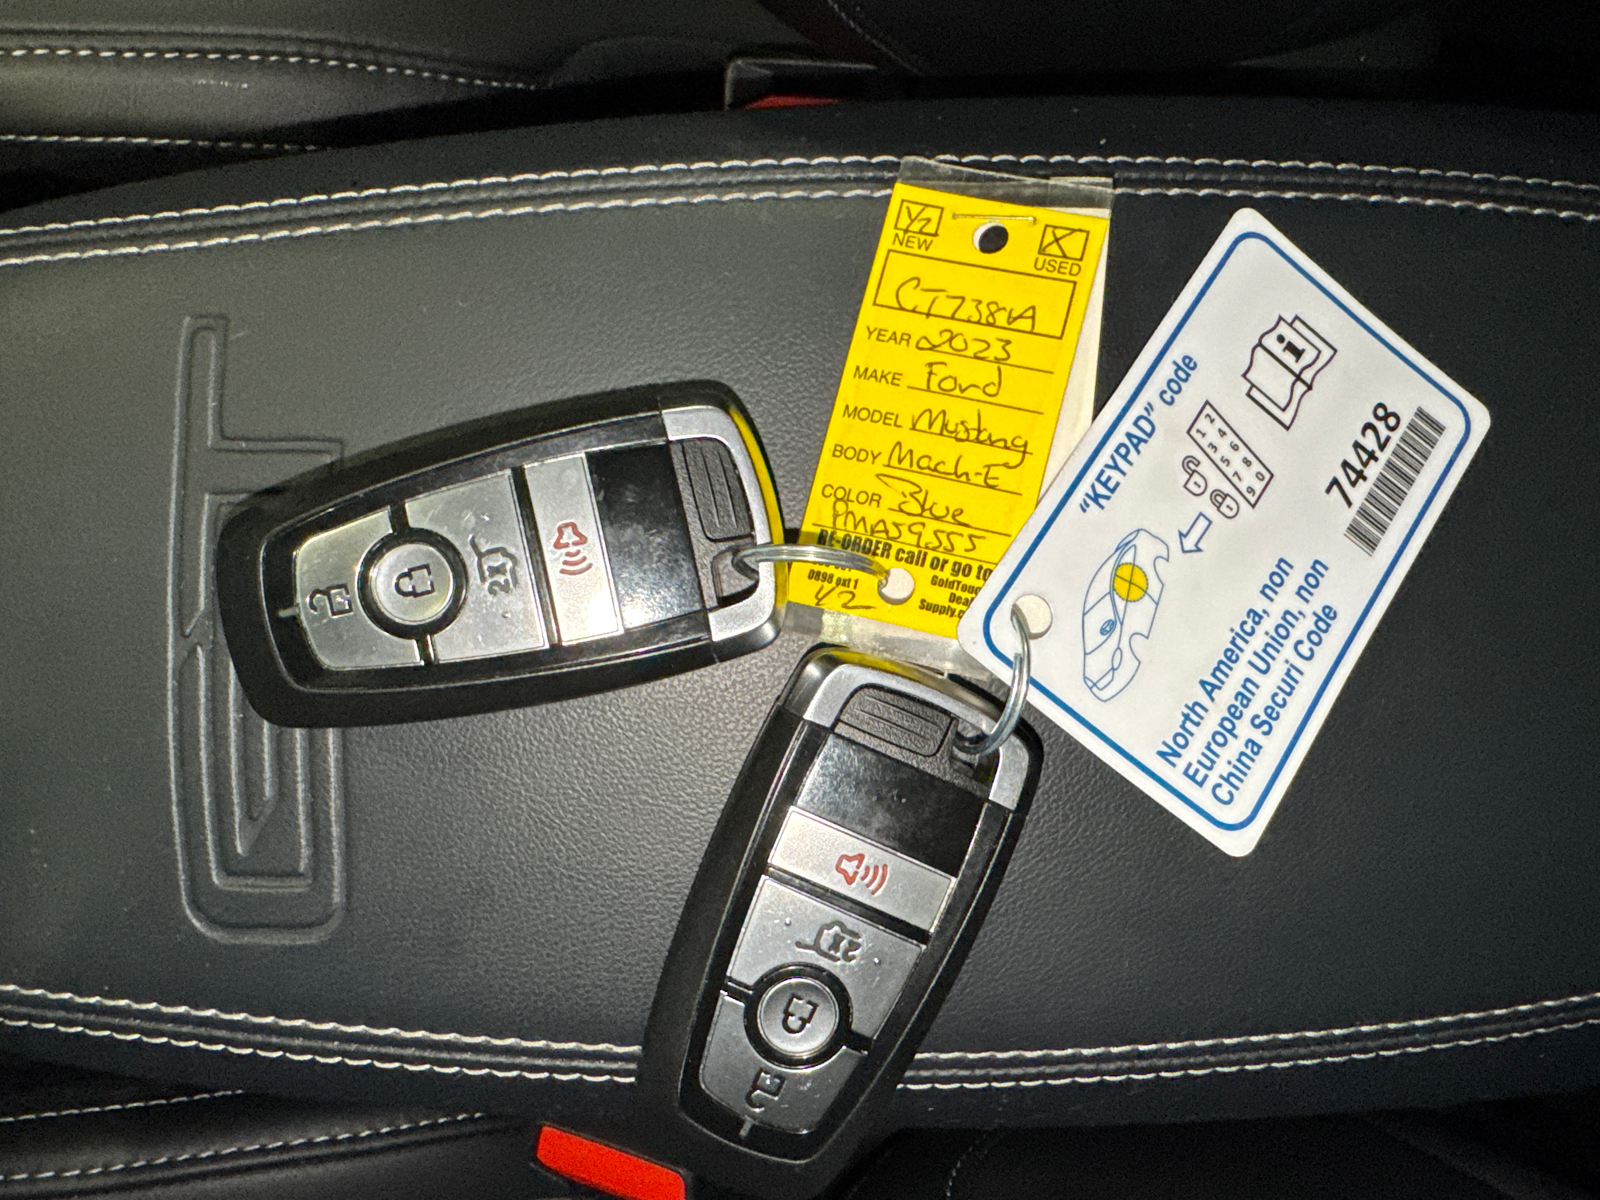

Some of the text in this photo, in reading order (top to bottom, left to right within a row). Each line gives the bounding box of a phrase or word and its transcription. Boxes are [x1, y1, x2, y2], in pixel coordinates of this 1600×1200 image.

[892, 232, 933, 251] NEW
[1033, 257, 1082, 277] USED
[866, 326, 911, 348] YEAR
[915, 329, 1012, 362] 2023
[853, 365, 902, 387] MAKE
[925, 361, 1002, 397] Ford
[1158, 354, 1198, 406] code
[842, 404, 903, 428] MODEL
[832, 444, 881, 465] BODY
[912, 408, 1028, 469] Mustang
[1325, 402, 1401, 509] 74428
[887, 441, 1003, 489] Mach-E
[821, 484, 882, 508] COLOR
[875, 473, 970, 527] Blue
[817, 528, 994, 582] RE-ORDER call or go to
[807, 569, 834, 584] 0898
[835, 577, 852, 588] ext
[1156, 557, 1294, 768] North America, non
[1182, 558, 1329, 788] European Union, non
[1211, 604, 1338, 806] China Securi Code
